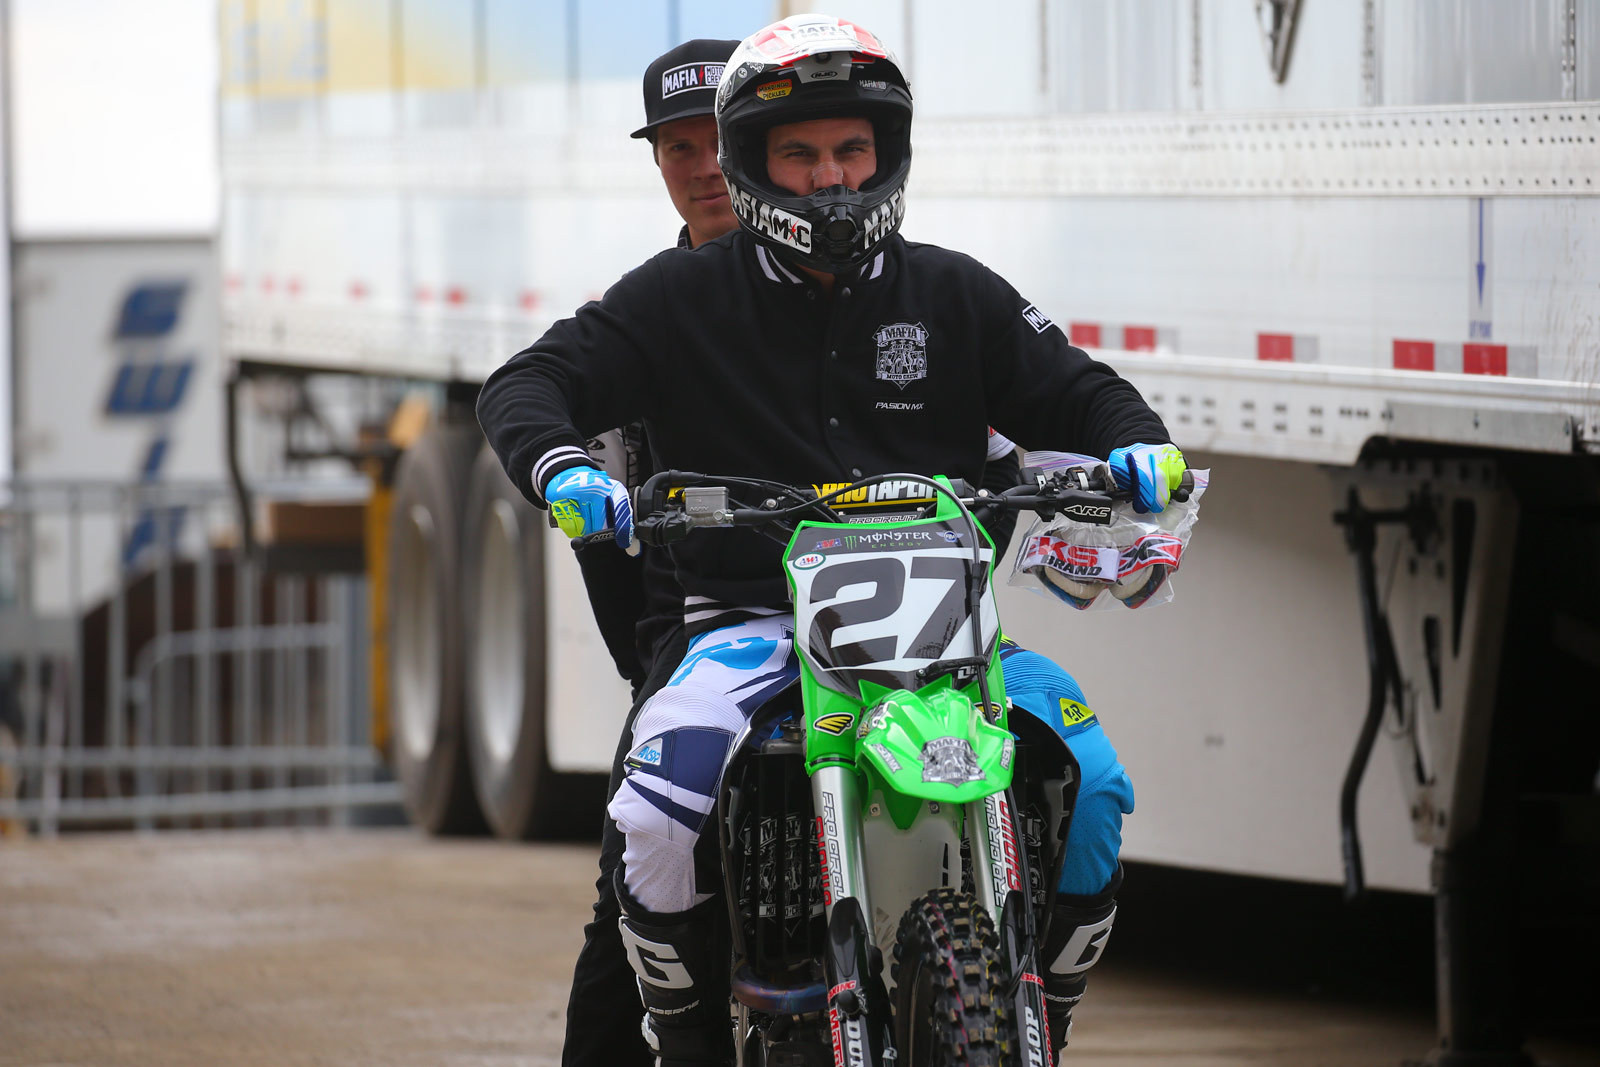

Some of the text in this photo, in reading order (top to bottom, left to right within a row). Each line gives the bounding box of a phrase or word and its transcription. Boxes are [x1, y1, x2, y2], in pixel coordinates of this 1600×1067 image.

[664, 68, 698, 94] MAFIA
[707, 75, 720, 84] CRE
[762, 90, 786, 99] PICKLES
[728, 182, 774, 237] AFIA
[885, 325, 917, 340] MAFIA
[875, 402, 911, 410] PASION
[1064, 505, 1111, 518] ARC
[859, 531, 932, 544] MONSTER
[871, 541, 923, 549] ENERGY
[1041, 554, 1102, 576] BRAND
[809, 556, 991, 668] 27
[930, 738, 967, 750] MAFIA
[822, 791, 845, 903] PRO CIRCU
[984, 796, 1006, 908] PRO CIRCUI
[847, 1019, 864, 1067] DUN
